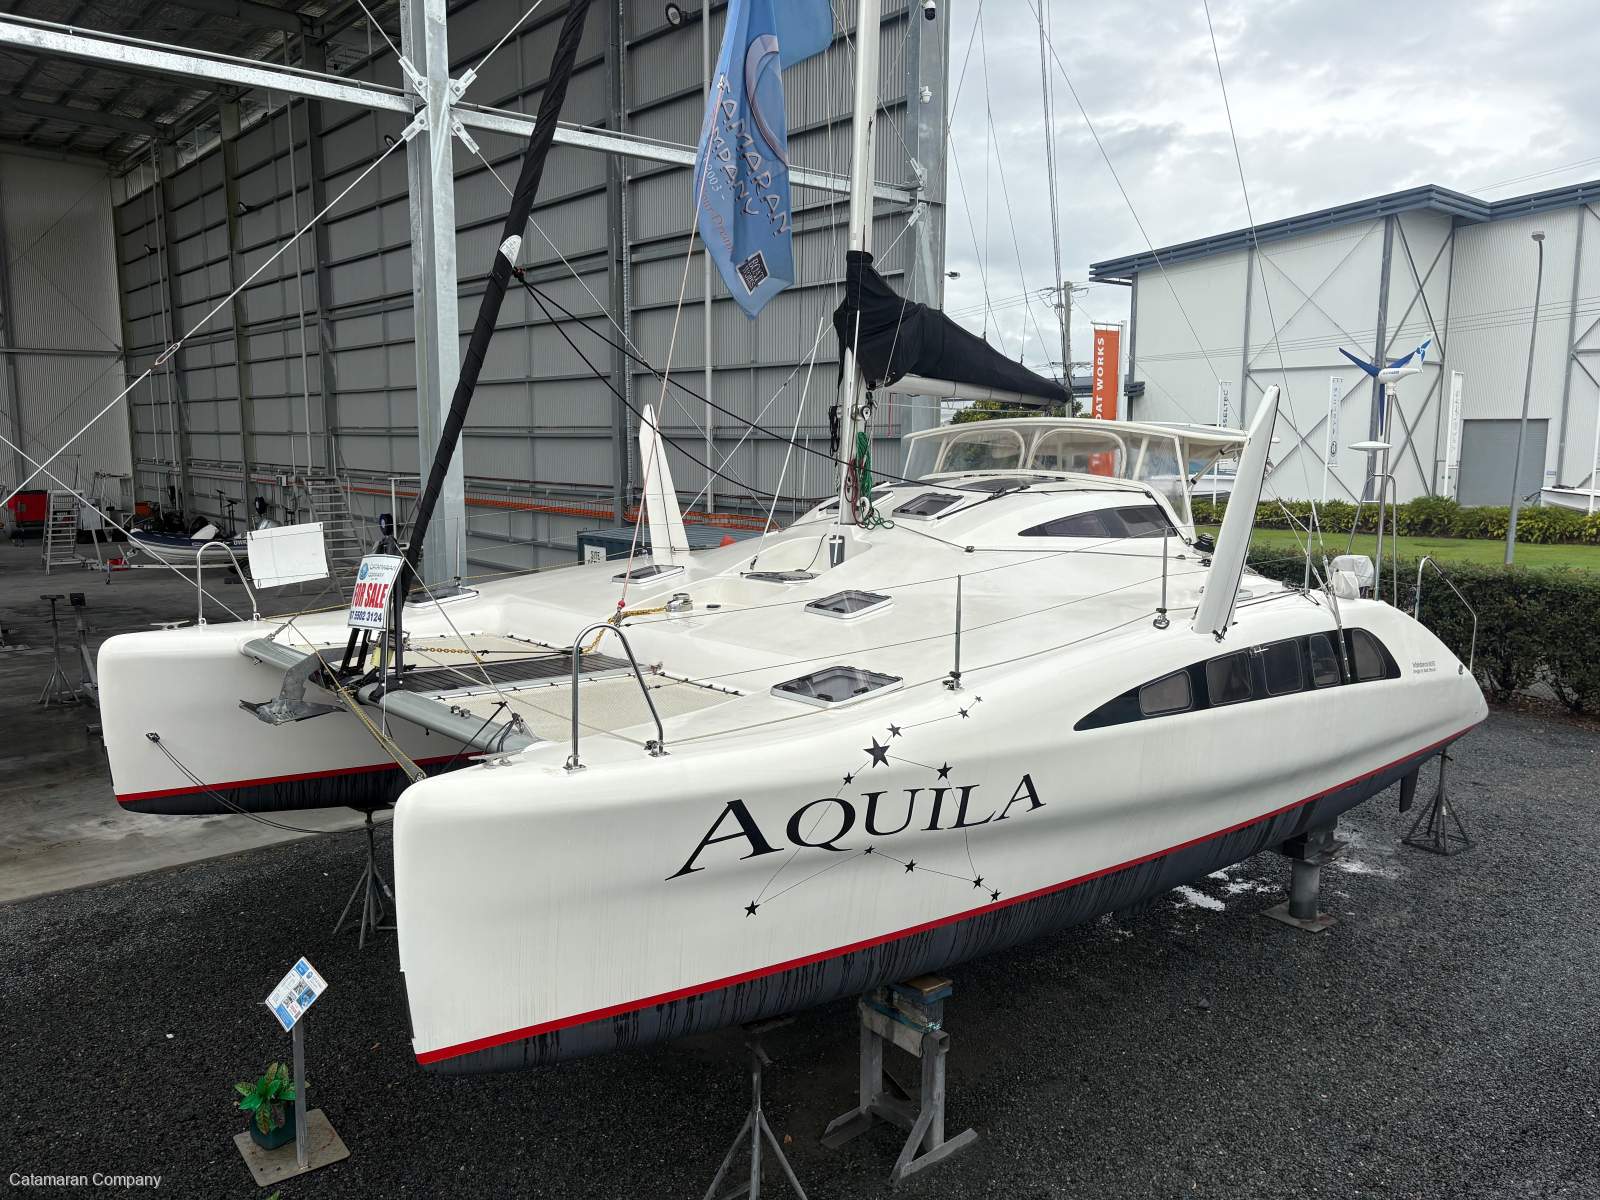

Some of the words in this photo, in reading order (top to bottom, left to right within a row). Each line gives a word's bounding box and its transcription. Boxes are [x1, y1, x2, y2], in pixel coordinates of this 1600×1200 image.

[721, 76, 791, 234] TAMARAN
[705, 164, 722, 192] 2003
[712, 126, 760, 215] MPANY
[749, 258, 765, 282] BOAT
[1097, 337, 1105, 390] WORKS
[1095, 396, 1103, 420] OAT
[352, 583, 367, 606] FOR
[364, 582, 389, 608] SALE
[366, 611, 382, 622] 3124
[665, 774, 1047, 881] AQUILA
